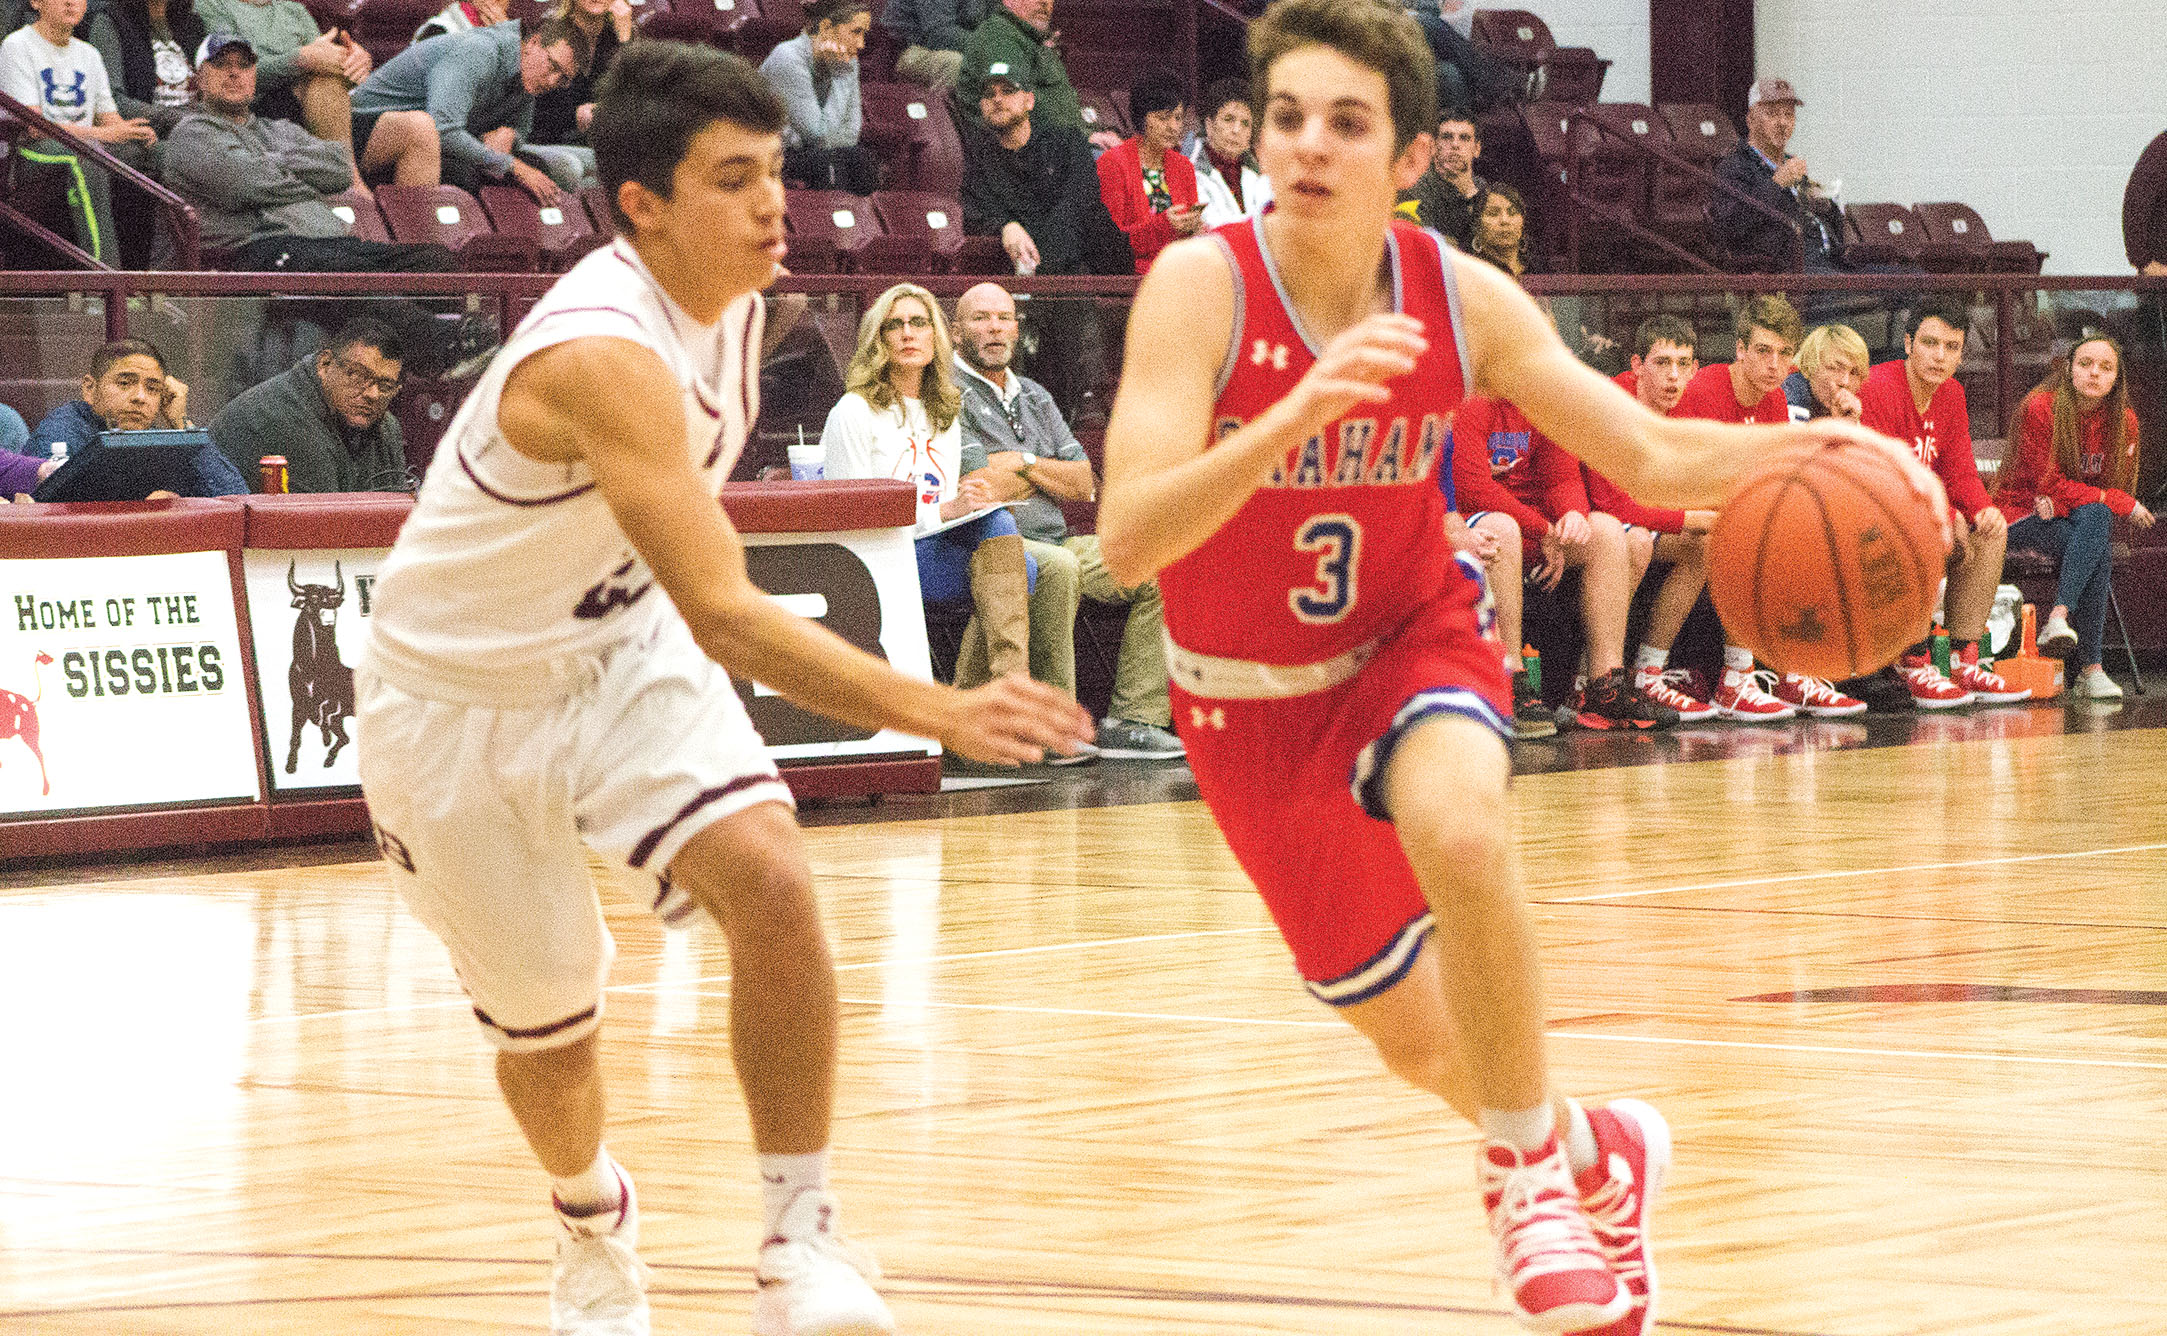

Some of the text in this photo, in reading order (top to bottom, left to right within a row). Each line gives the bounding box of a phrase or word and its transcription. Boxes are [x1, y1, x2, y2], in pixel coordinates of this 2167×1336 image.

[1216, 411, 1454, 489] AHA
[1288, 512, 1362, 626] 3
[14, 594, 201, 631] HOME OF THE
[62, 645, 225, 698] SISSIES
